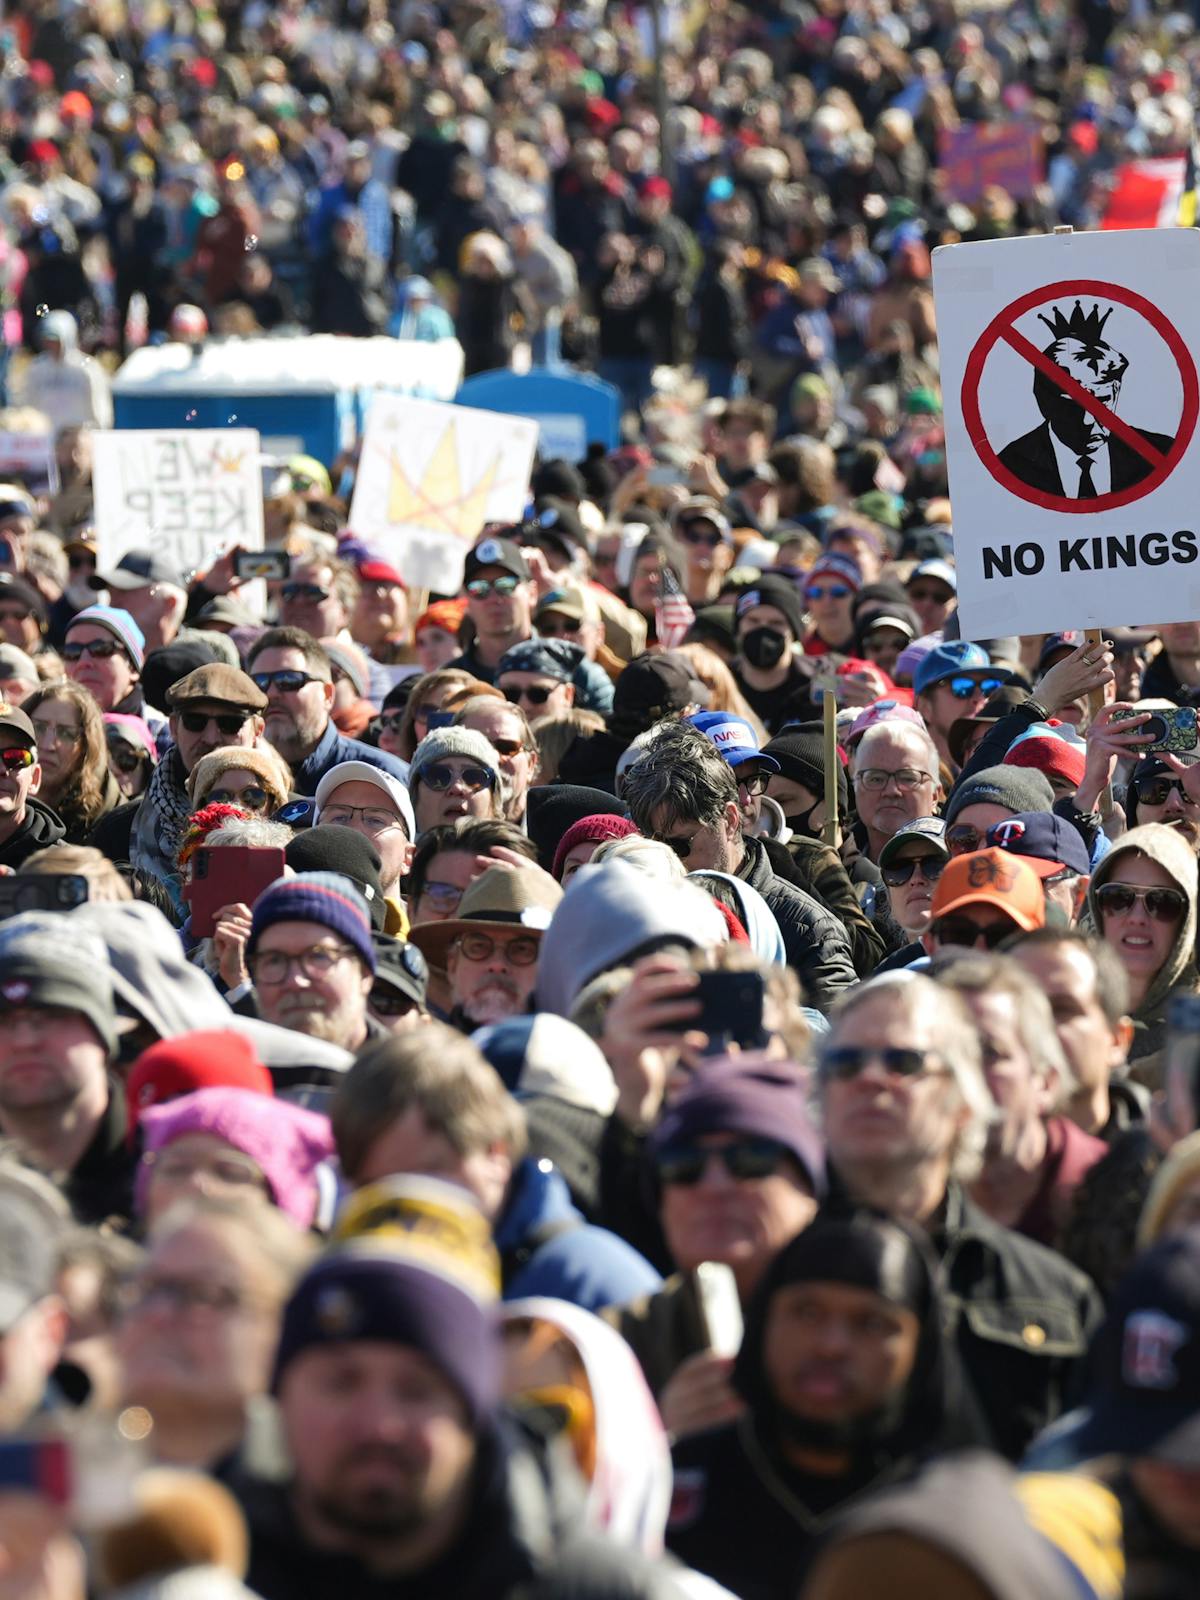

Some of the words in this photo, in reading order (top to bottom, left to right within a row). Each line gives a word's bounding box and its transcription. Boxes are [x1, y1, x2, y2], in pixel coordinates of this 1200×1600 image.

[982, 542, 1045, 580] NO
[1059, 530, 1199, 572] KINGS
[713, 729, 750, 743] NAS
